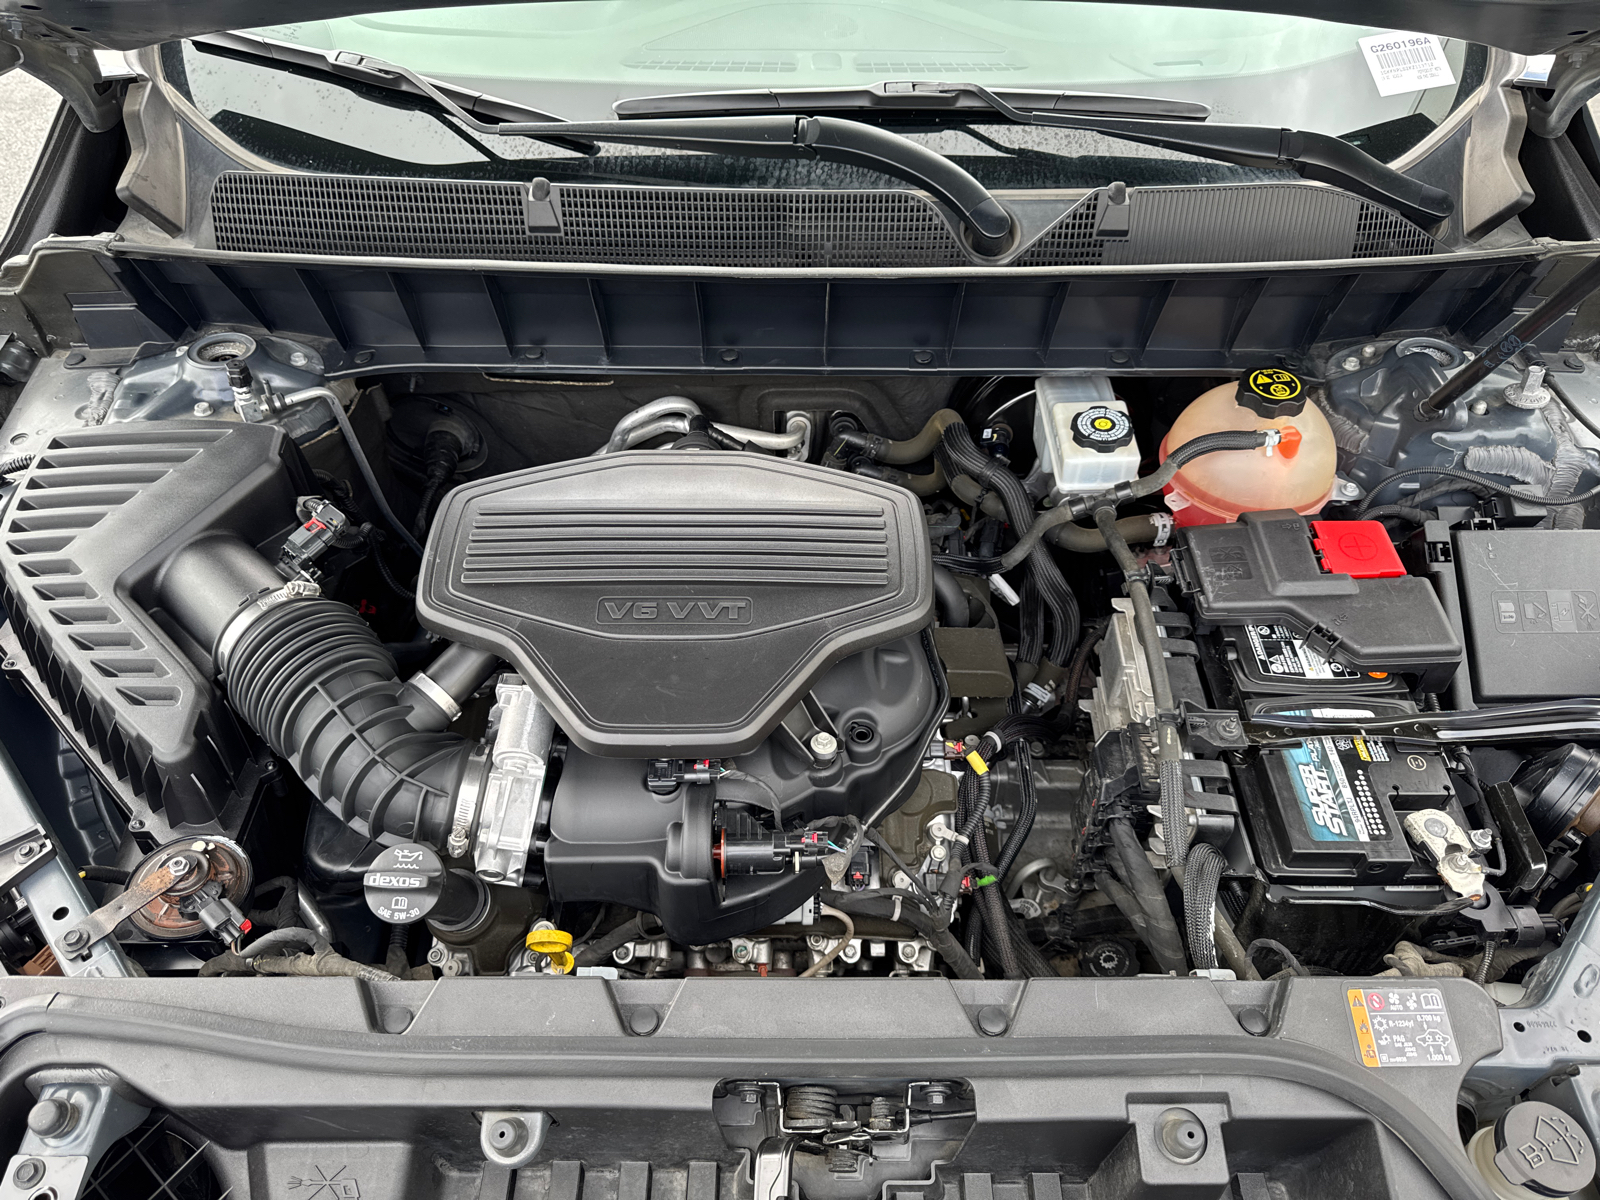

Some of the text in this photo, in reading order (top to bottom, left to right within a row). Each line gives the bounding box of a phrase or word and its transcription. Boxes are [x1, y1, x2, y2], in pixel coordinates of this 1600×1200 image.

[1370, 36, 1431, 53] G260196A
[604, 602, 747, 619] V6 VVT
[1327, 746, 1335, 755] 140
[1338, 777, 1348, 789] 850
[1298, 763, 1325, 826] SUPER
[1314, 764, 1348, 837] START
[369, 873, 422, 887] dexos
[377, 906, 420, 920] SAE 5W-30
[1388, 1020, 1414, 1028] R-1234yf
[1432, 1015, 1441, 1023] kg
[1443, 1054, 1452, 1062] kg
